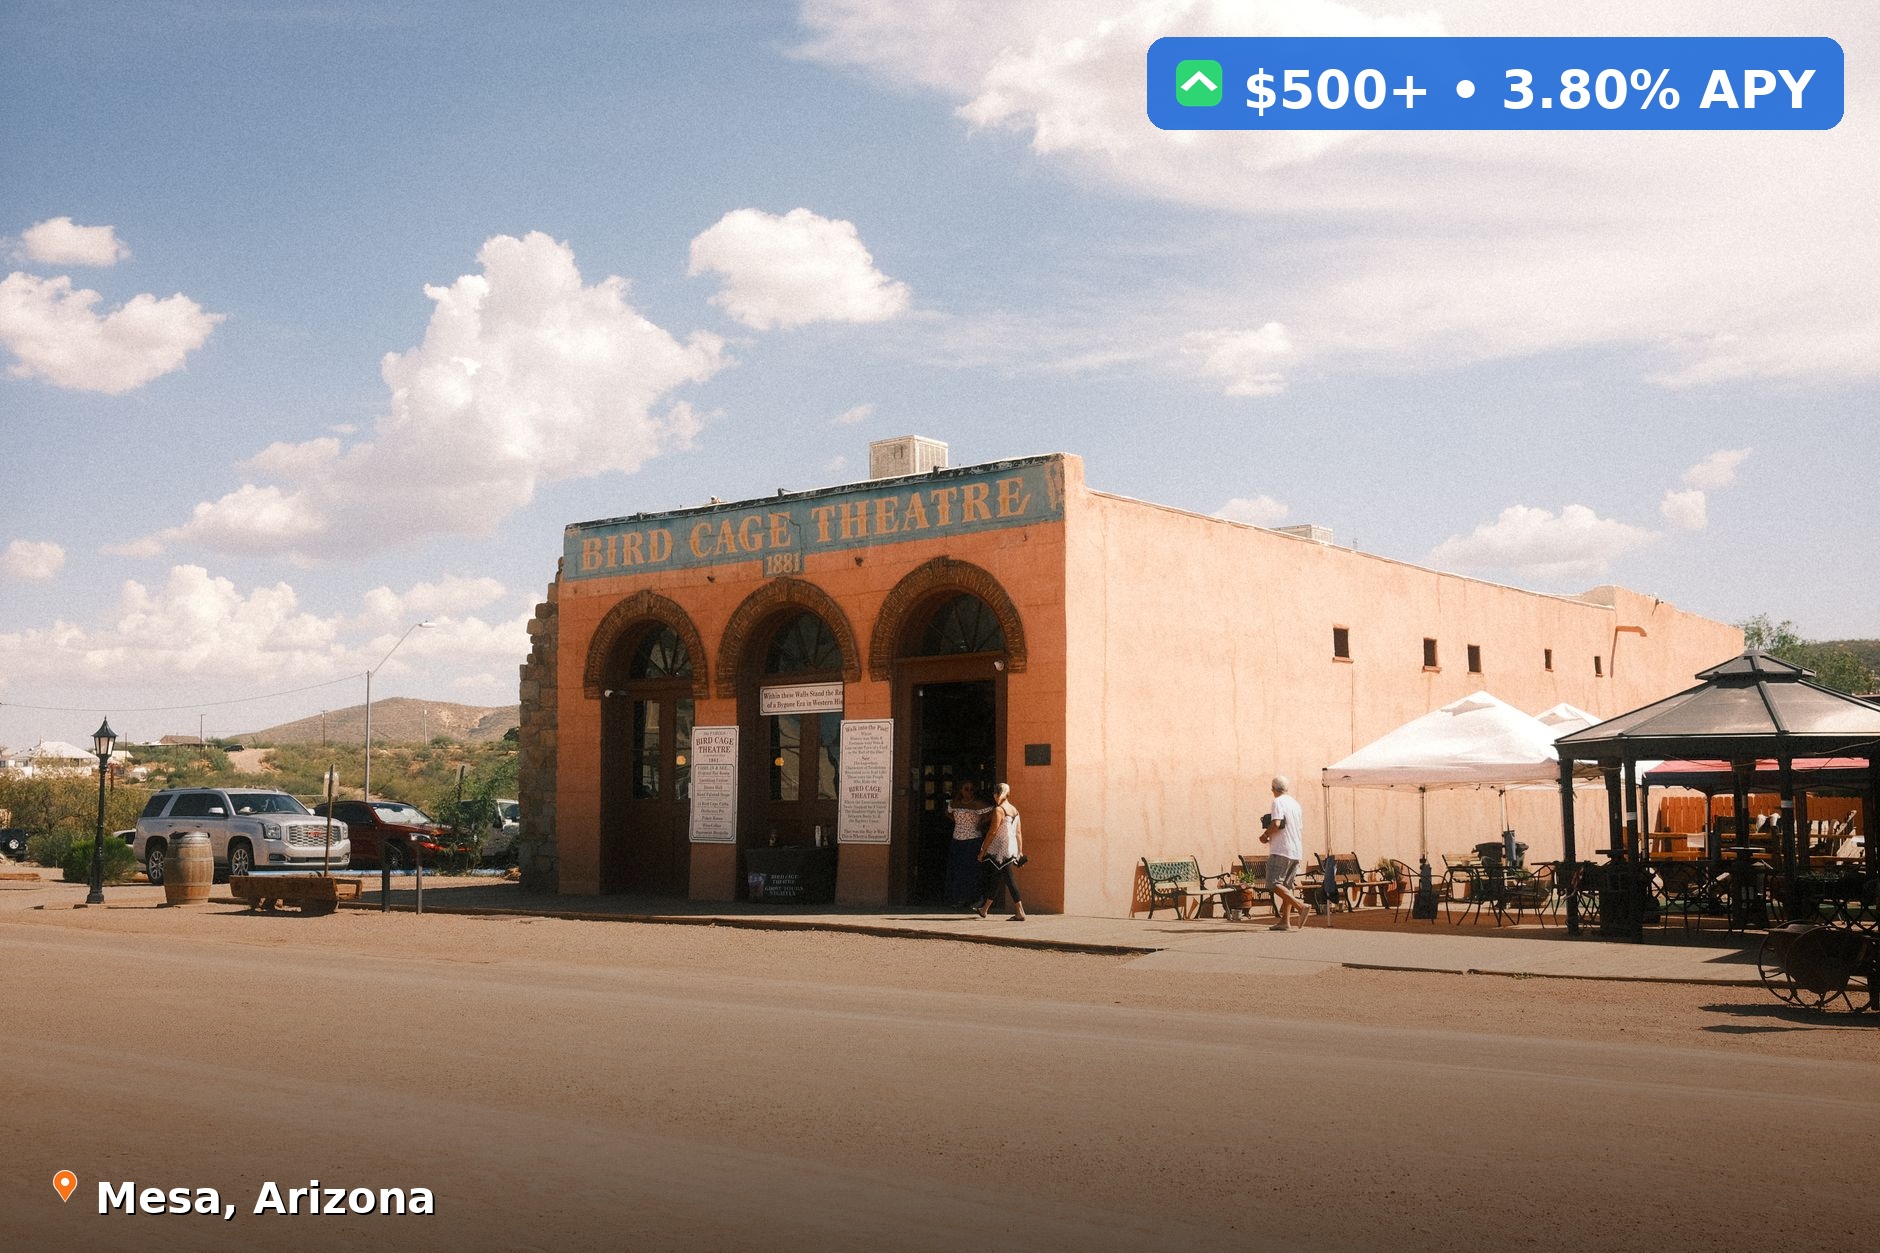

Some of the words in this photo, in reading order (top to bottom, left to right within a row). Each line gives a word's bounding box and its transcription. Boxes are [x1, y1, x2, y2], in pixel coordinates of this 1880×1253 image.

[581, 527, 674, 572] BIRD
[689, 511, 793, 559] CAGE
[811, 476, 1032, 544] THEATRE
[766, 552, 801, 576] 1881
[764, 692, 781, 700] Within
[781, 691, 795, 699] these
[795, 690, 809, 698] Walls
[810, 689, 825, 697] Stand
[825, 688, 834, 696] the
[835, 688, 843, 696] Re
[696, 736, 713, 746] BIRD
[714, 736, 734, 746] CAGE
[848, 785, 864, 793] BIRD
[865, 785, 881, 793] CAGE
